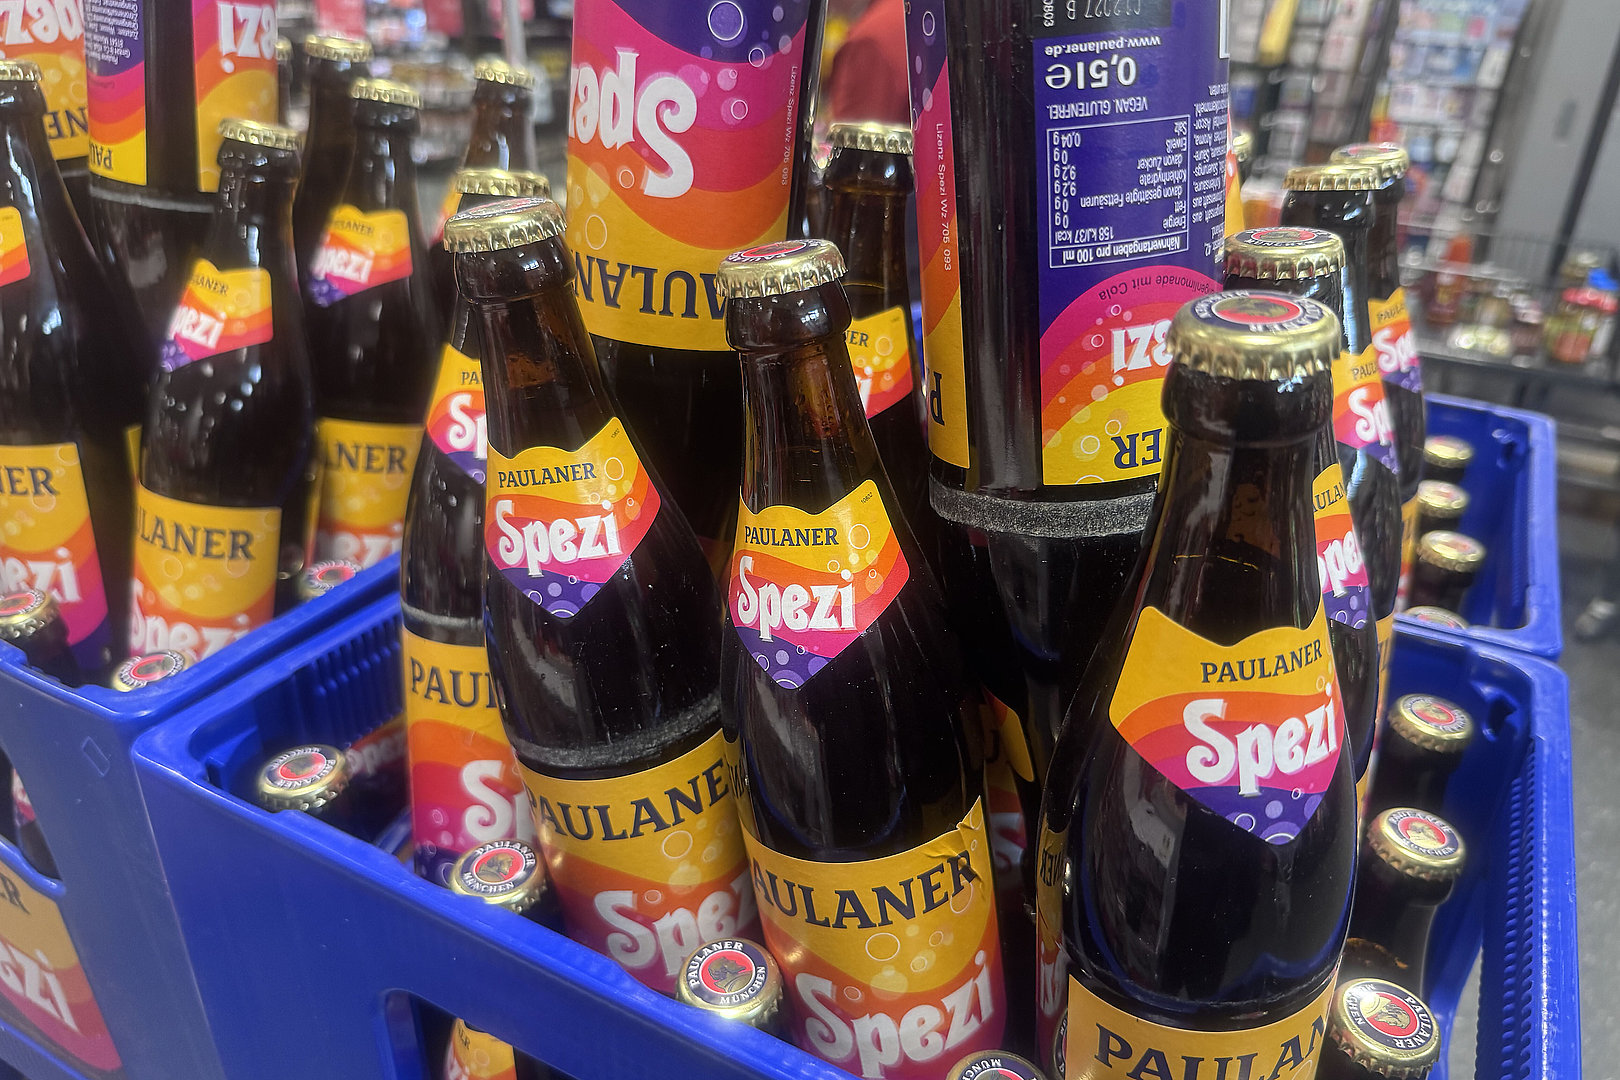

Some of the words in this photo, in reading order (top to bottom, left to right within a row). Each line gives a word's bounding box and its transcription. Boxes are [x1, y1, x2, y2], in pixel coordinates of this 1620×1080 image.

[1045, 36, 1160, 57] www.paulaner.de
[788, 66, 798, 96] Lizenz
[786, 98, 794, 125] Spezi
[1046, 99, 1111, 120] GLUTENFREI.
[1113, 96, 1148, 114] VEGAN.
[1174, 120, 1187, 134] Salz
[936, 123, 945, 160] Lizenz
[1053, 131, 1060, 144] g
[1062, 131, 1081, 147] 0,04
[1053, 148, 1060, 160] g
[1061, 150, 1068, 164] 0
[1163, 153, 1182, 169] davon
[1054, 164, 1060, 176] g
[1137, 156, 1162, 170] Zucker
[938, 164, 947, 195] Spezi
[1062, 165, 1076, 181] 9,2
[1140, 169, 1186, 186] Kohlenhydrate
[1054, 179, 1060, 192] g
[1062, 181, 1077, 197] 9,2
[1163, 185, 1182, 202] davon
[1054, 196, 1061, 209] g
[1080, 193, 1124, 209] Fettsäuren
[1126, 187, 1162, 206] gesättigte
[940, 199, 948, 219] Wz
[1063, 199, 1069, 213] 0
[1174, 200, 1186, 213] Fett
[1054, 212, 1061, 225] g
[1063, 215, 1069, 228] 0
[1163, 214, 1186, 231] Energie
[1055, 231, 1072, 244] kcal
[1074, 229, 1097, 243] kJ/37
[1099, 225, 1114, 241] 158
[1096, 243, 1111, 258] pro
[1113, 236, 1180, 257] Nährwertangaben
[943, 248, 952, 271] 093
[1063, 251, 1075, 263] ml
[1077, 249, 1093, 262] 100
[1098, 282, 1128, 301] Cola
[1132, 276, 1151, 291] mit
[498, 462, 597, 489] PAULANER
[495, 499, 625, 578] Spezi
[744, 525, 840, 547] PAULANER
[736, 555, 859, 643] Spezi
[1200, 638, 1323, 684] PAULANER
[1182, 681, 1339, 798] Spezi
[686, 940, 744, 988] PAULANER
[719, 965, 767, 1005] MÜNCHEN
[794, 949, 995, 1080] Spezi
[1392, 995, 1432, 1049] PAULANER
